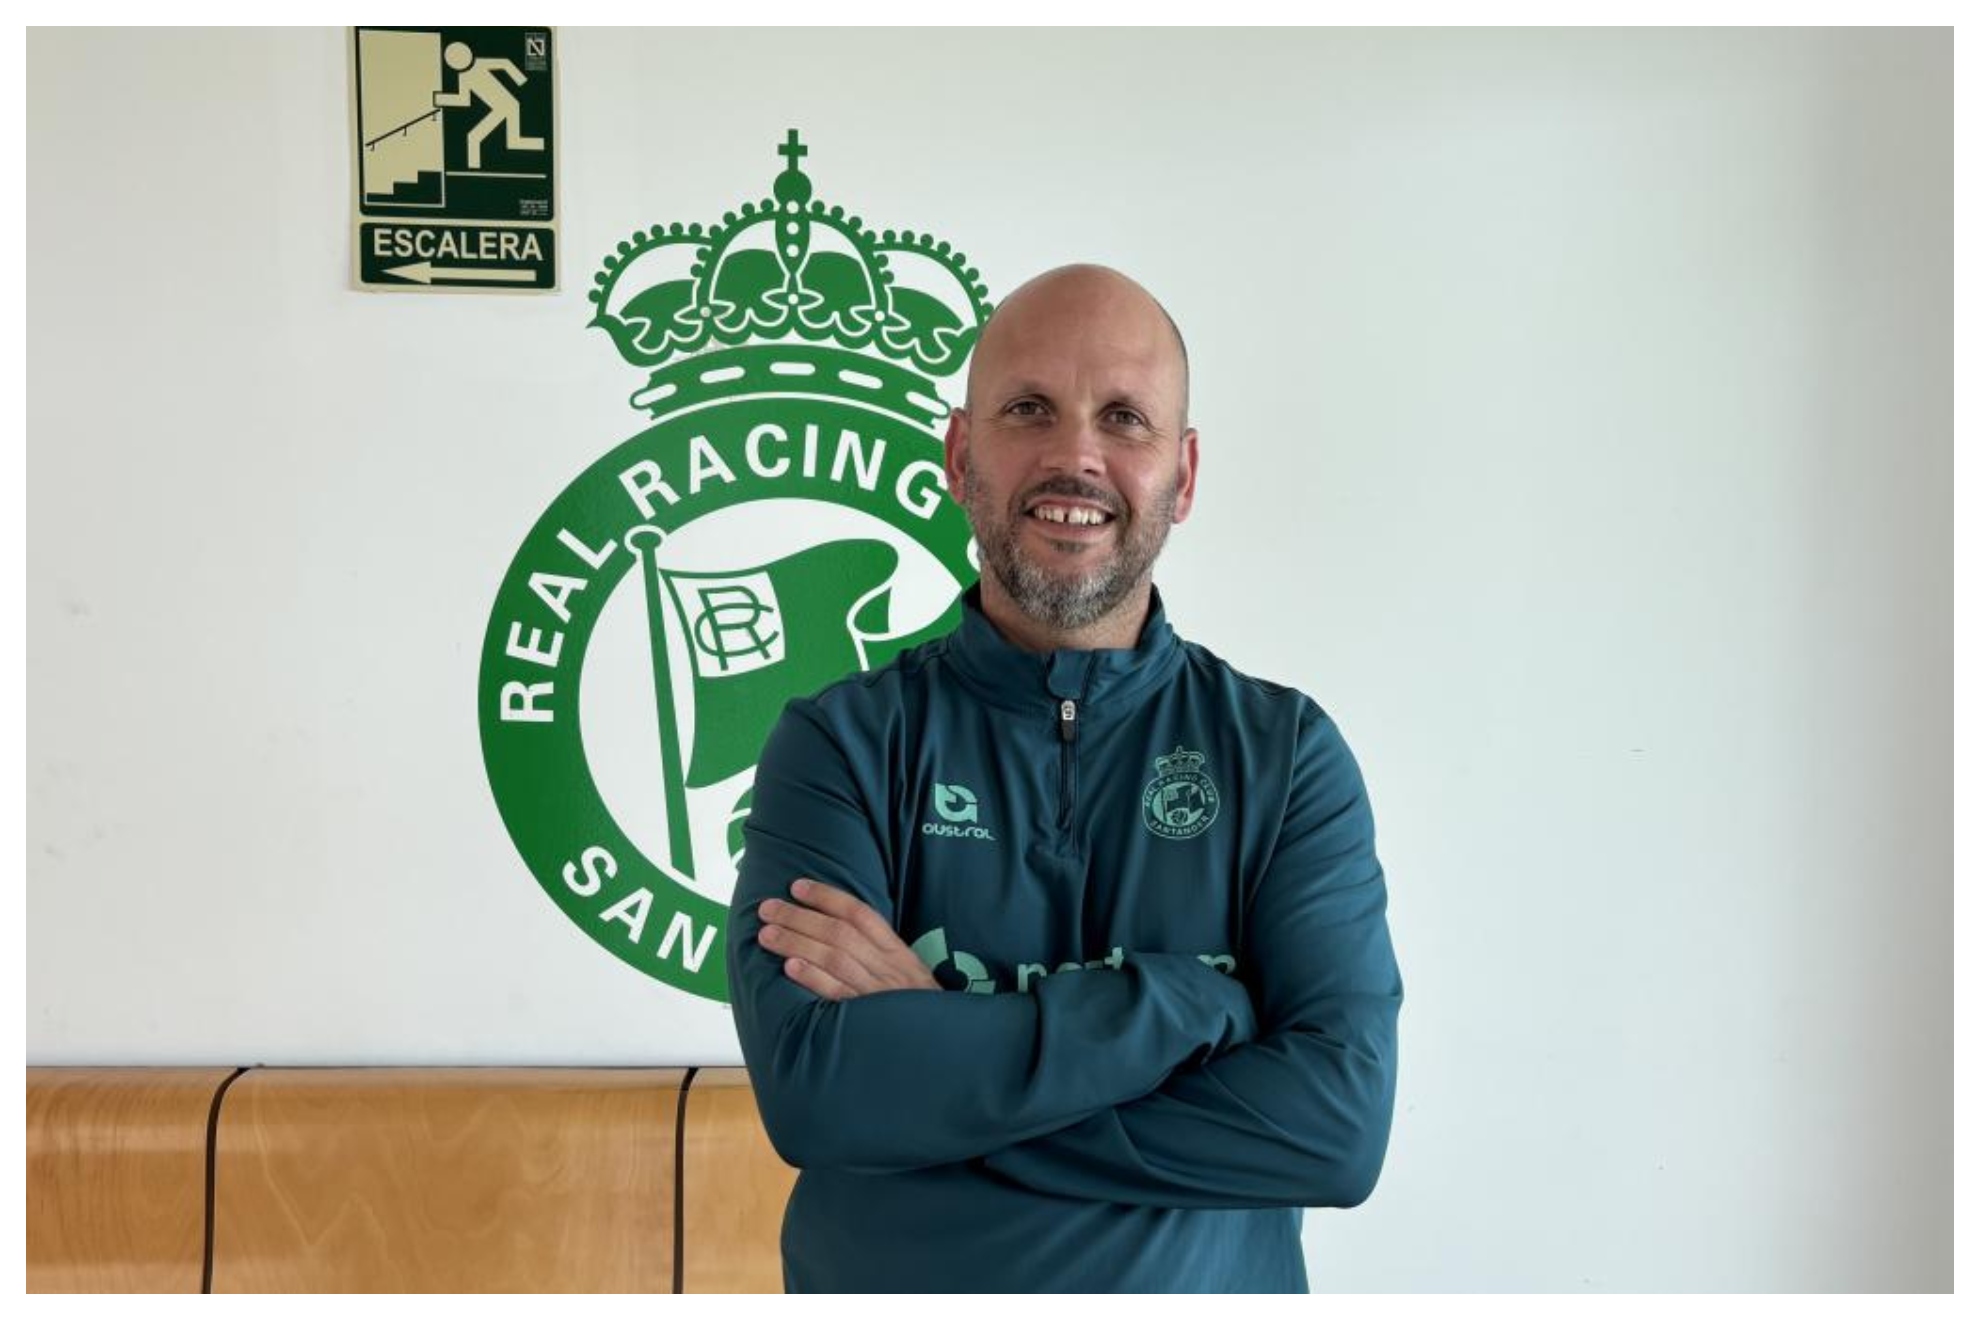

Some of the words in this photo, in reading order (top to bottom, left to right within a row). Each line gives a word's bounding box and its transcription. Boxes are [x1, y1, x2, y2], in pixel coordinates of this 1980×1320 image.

[373, 228, 543, 262] ESCALERA
[499, 526, 618, 724] REAL
[617, 423, 949, 519] RACING
[1149, 815, 1210, 836] SANTANDER
[561, 845, 719, 974] SAN
